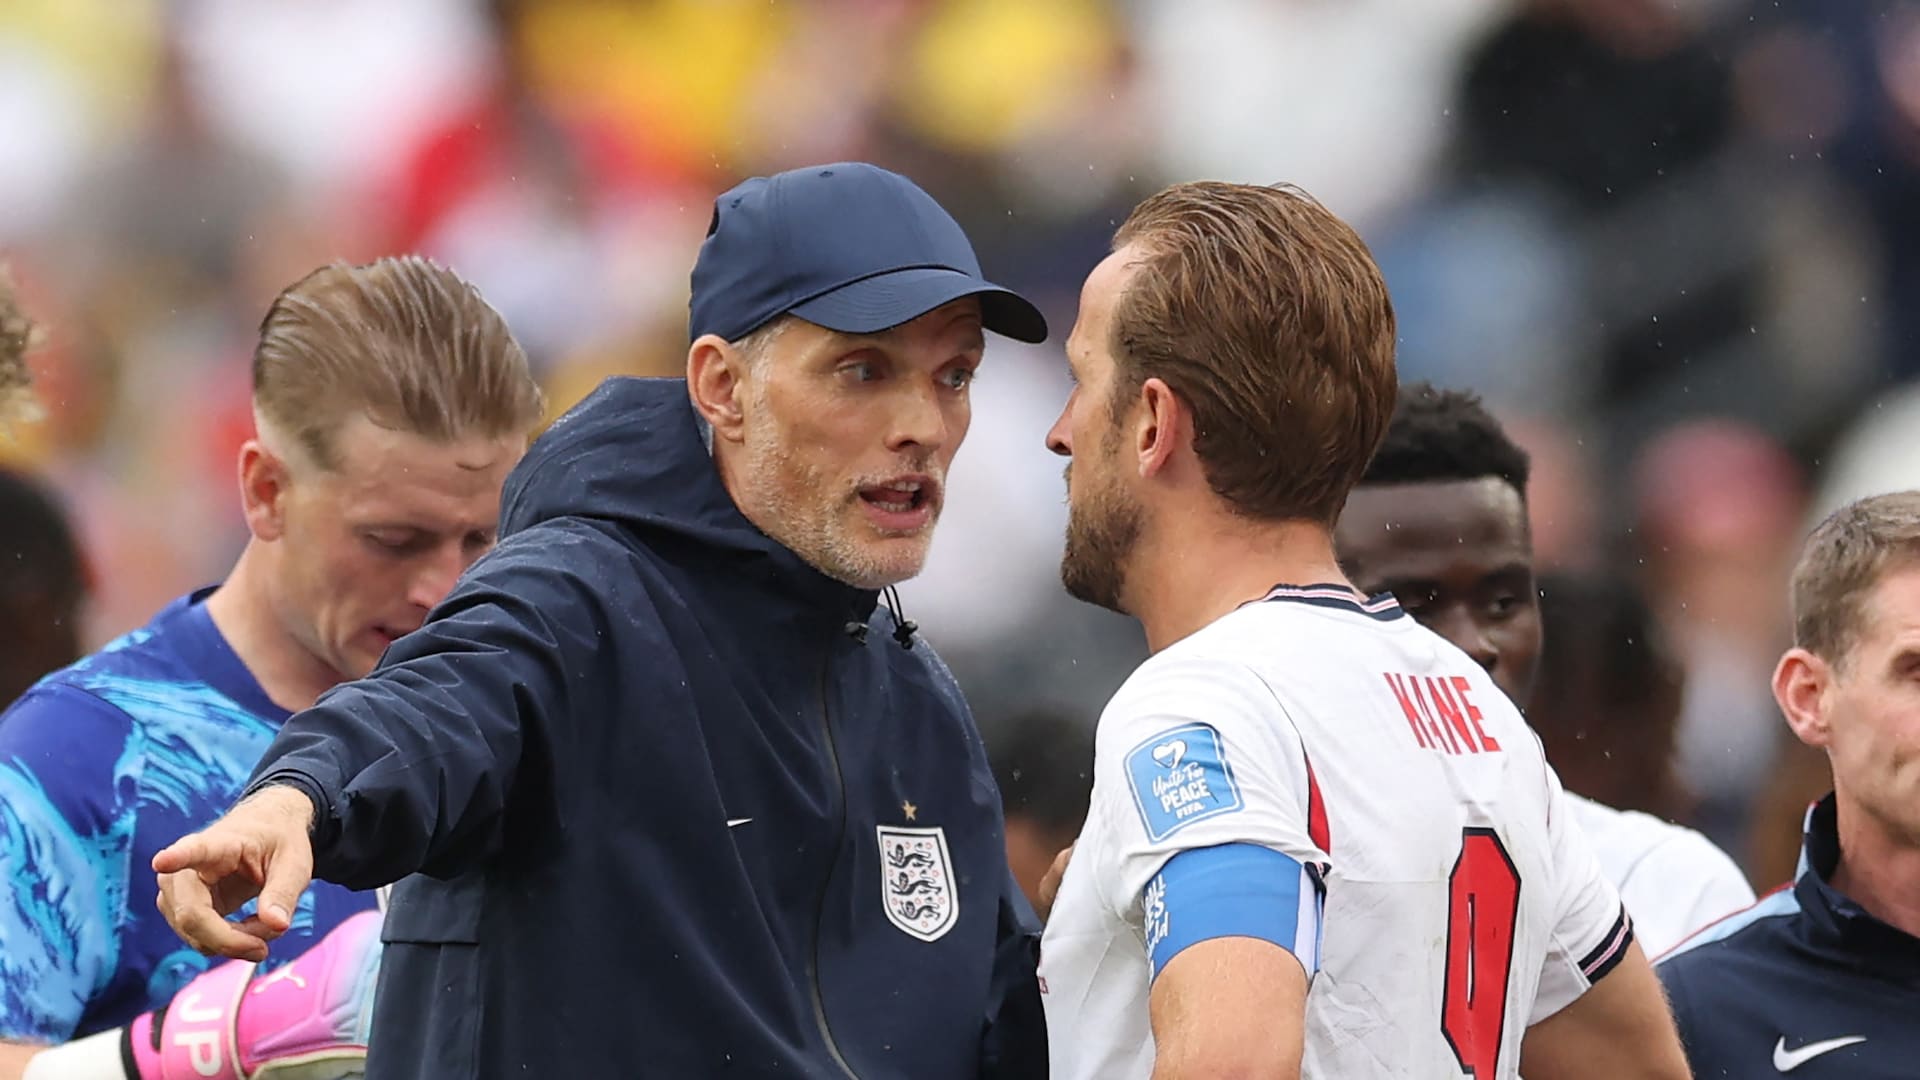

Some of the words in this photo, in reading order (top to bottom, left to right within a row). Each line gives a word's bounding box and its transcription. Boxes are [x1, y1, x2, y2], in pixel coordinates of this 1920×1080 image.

[1383, 672, 1501, 754] KANE
[1152, 769, 1185, 797] Unite
[1182, 761, 1205, 781] For
[1160, 778, 1210, 812] PEACE
[1176, 801, 1205, 819] FIFA
[1441, 827, 1521, 1080] 9
[173, 993, 223, 1076] JP
